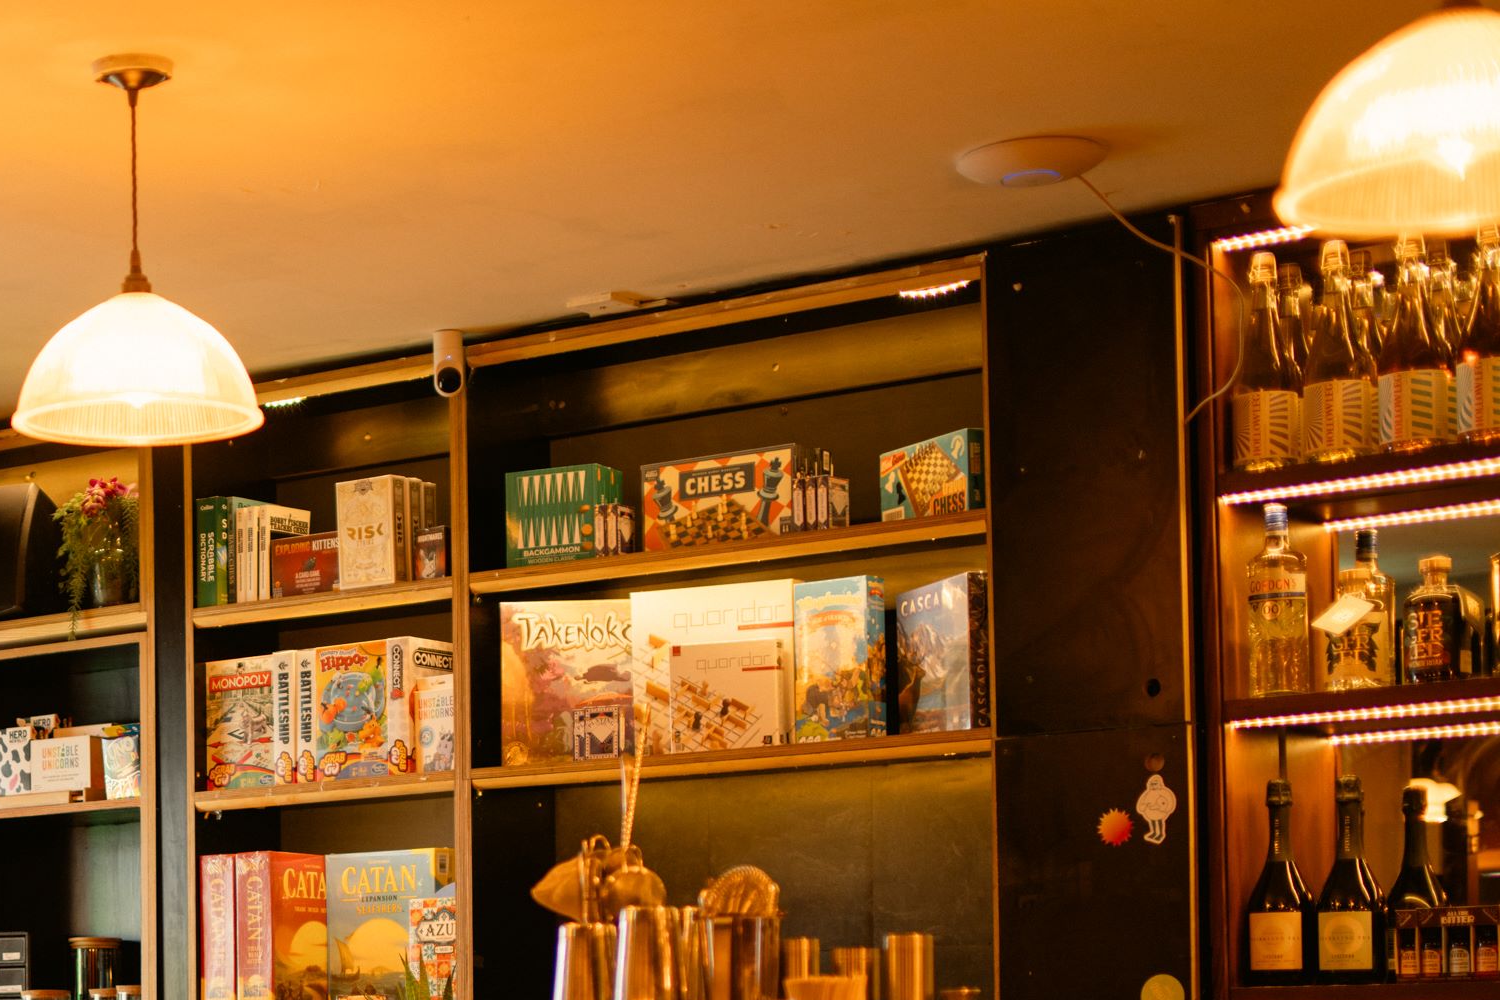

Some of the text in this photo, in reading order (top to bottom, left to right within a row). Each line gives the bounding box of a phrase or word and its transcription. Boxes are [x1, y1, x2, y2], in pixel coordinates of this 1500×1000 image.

[685, 471, 746, 496] CHESS
[934, 491, 965, 515] CHESS
[346, 522, 384, 541] RISK
[275, 537, 339, 556] EXPLODING KITTENS
[523, 546, 580, 557] BACKGAMMON
[207, 532, 215, 582] SCRABBLE
[674, 600, 786, 633] quoridor
[392, 646, 401, 688] CONNECT
[414, 651, 453, 668] CONNECT
[696, 651, 771, 673] quoridor
[211, 673, 270, 690] MONOPOLY
[278, 672, 290, 744] BATTLESHIP
[300, 670, 312, 743] BATTLESHIP
[418, 707, 453, 720] UNICORNS
[9, 730, 27, 740] HERD
[42, 745, 79, 759] UNSTABLE
[42, 757, 80, 771] UNICORNS
[341, 864, 418, 894] CATAN
[247, 876, 262, 940] CATAN
[362, 895, 399, 903] EXPANSION
[211, 878, 226, 942] CATAN
[426, 923, 454, 937] AZU
